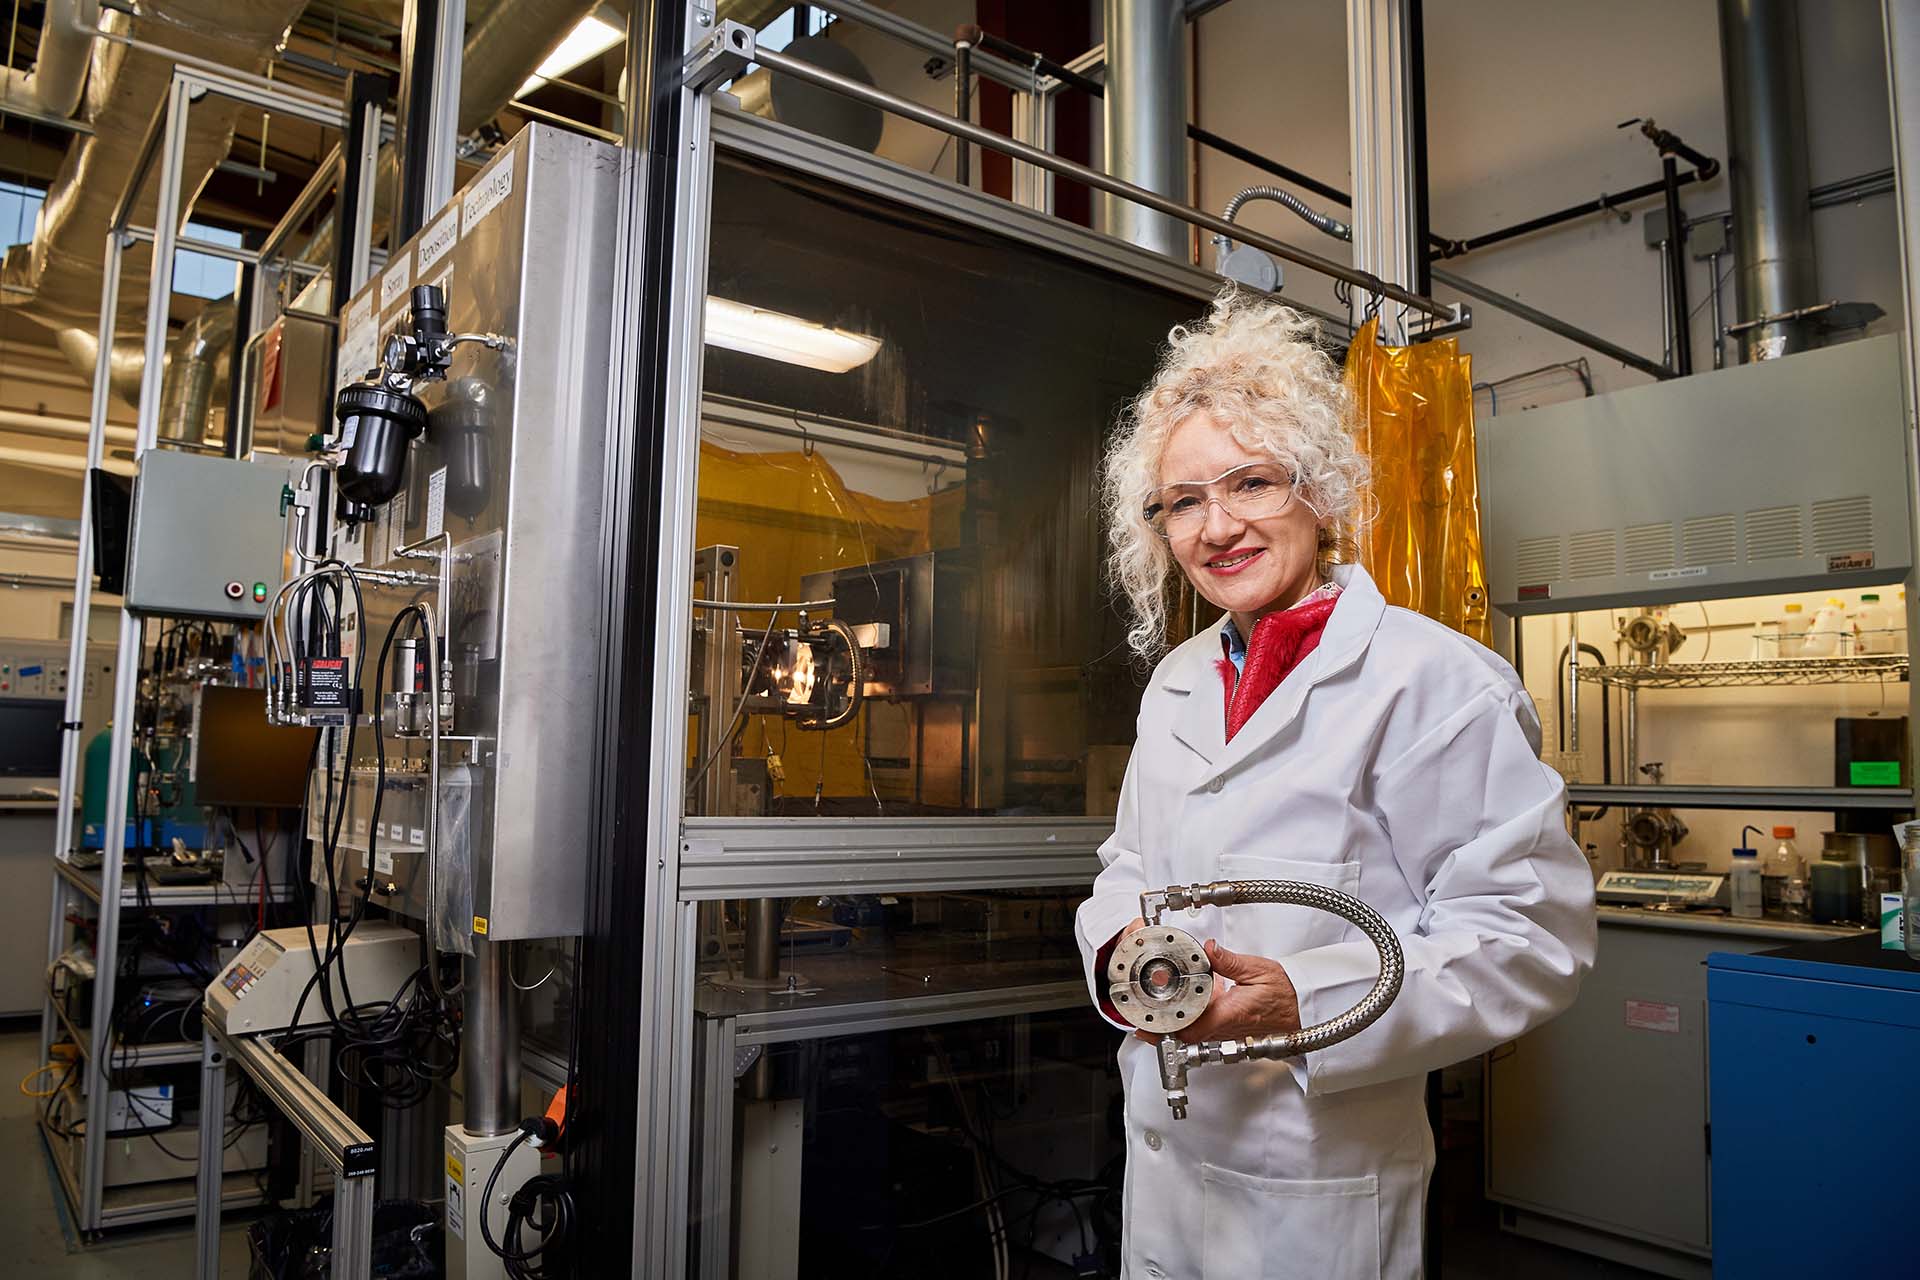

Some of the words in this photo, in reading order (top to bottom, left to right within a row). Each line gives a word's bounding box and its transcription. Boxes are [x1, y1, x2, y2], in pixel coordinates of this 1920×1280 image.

[419, 223, 457, 267] Deposition
[464, 168, 512, 223] Technology
[350, 1146, 374, 1154] 8020.net
